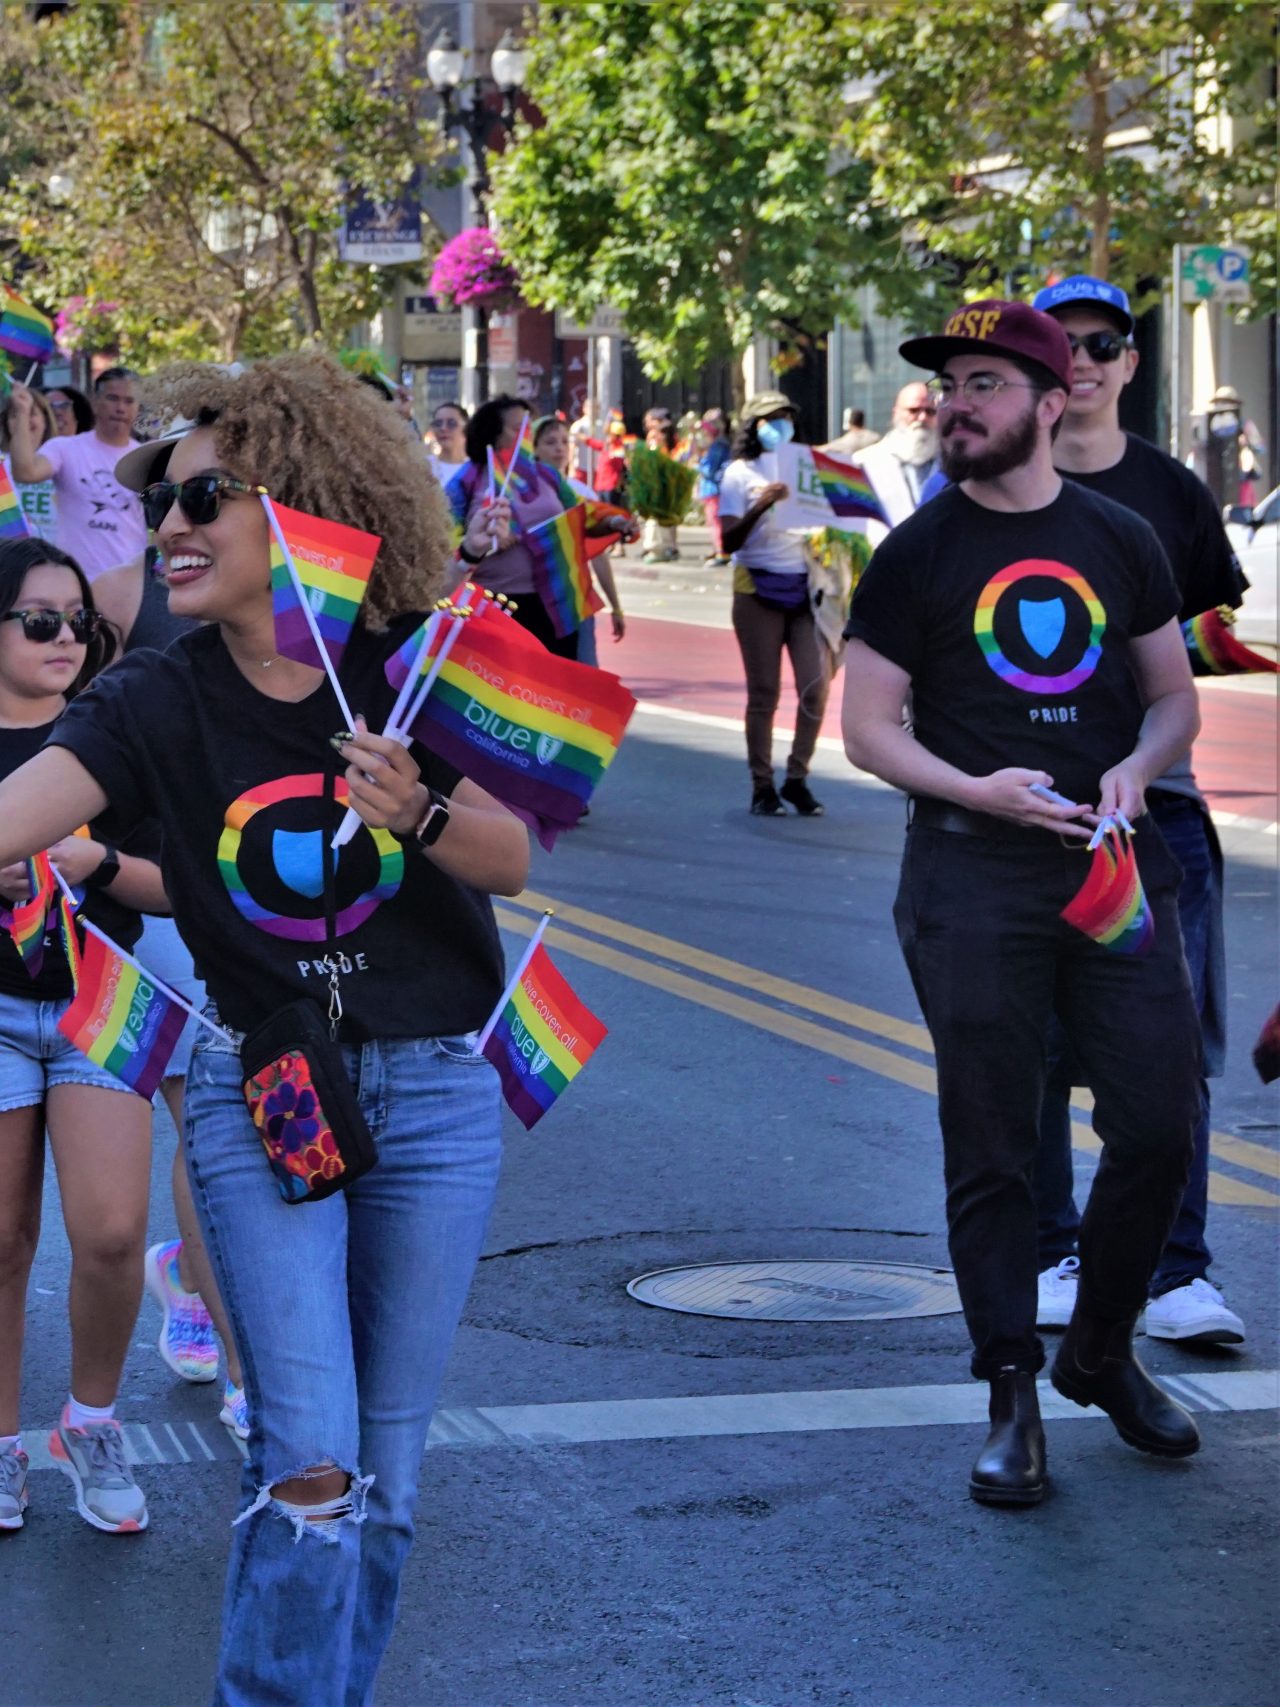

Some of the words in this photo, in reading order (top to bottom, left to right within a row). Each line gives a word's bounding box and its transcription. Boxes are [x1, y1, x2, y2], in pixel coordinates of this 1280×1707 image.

[1052, 282, 1094, 299] blue
[797, 470, 824, 496] LE
[465, 655, 505, 689] love
[508, 684, 566, 715] covers
[463, 697, 531, 750] blue
[1028, 706, 1078, 724] PRIDE
[465, 727, 530, 768] california
[535, 999, 561, 1036] covers
[560, 1033, 578, 1055] all.
